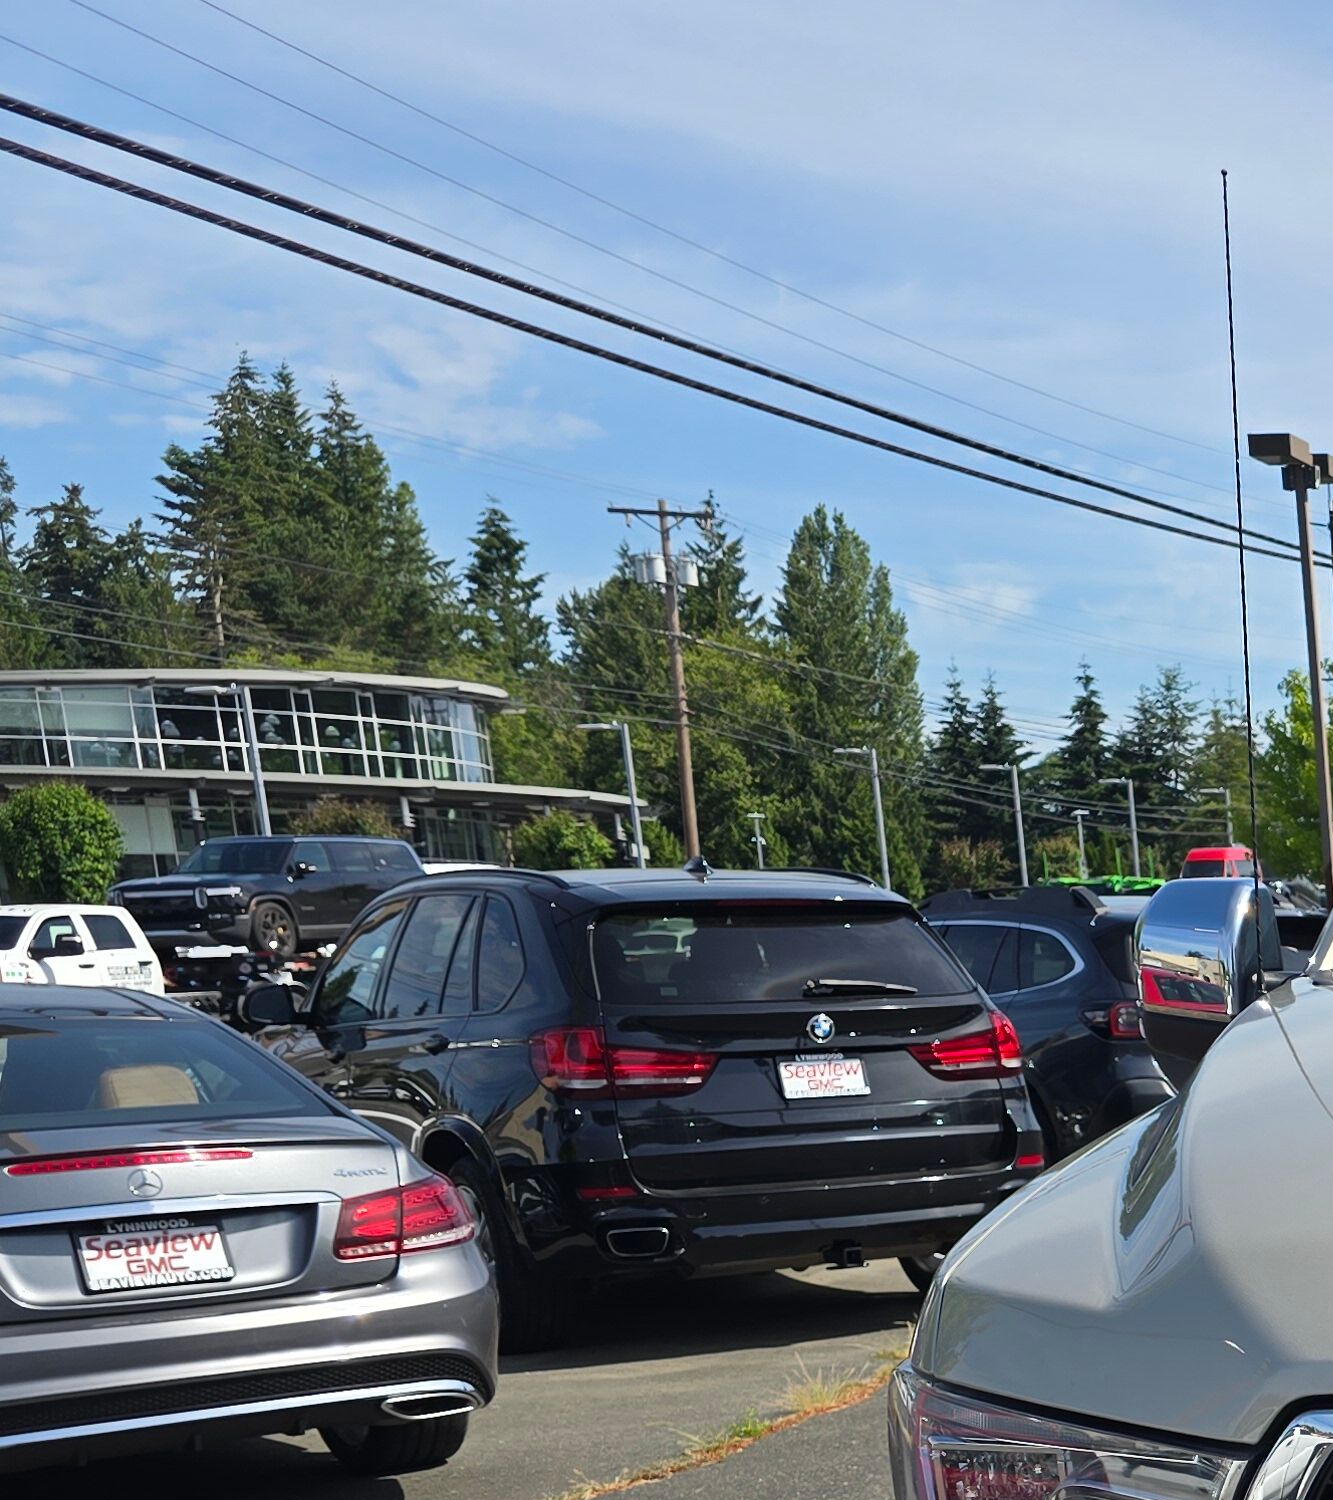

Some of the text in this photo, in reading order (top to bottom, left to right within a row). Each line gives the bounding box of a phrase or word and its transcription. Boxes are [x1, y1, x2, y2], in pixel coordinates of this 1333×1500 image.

[784, 1060, 861, 1079] Seaview
[808, 1078, 844, 1090] GMC
[106, 1218, 189, 1234] LYNNWOOD
[85, 1231, 217, 1261] Seaview
[126, 1256, 190, 1275] GMC
[89, 1267, 235, 1291] SEAVIEWAUTO.COM
